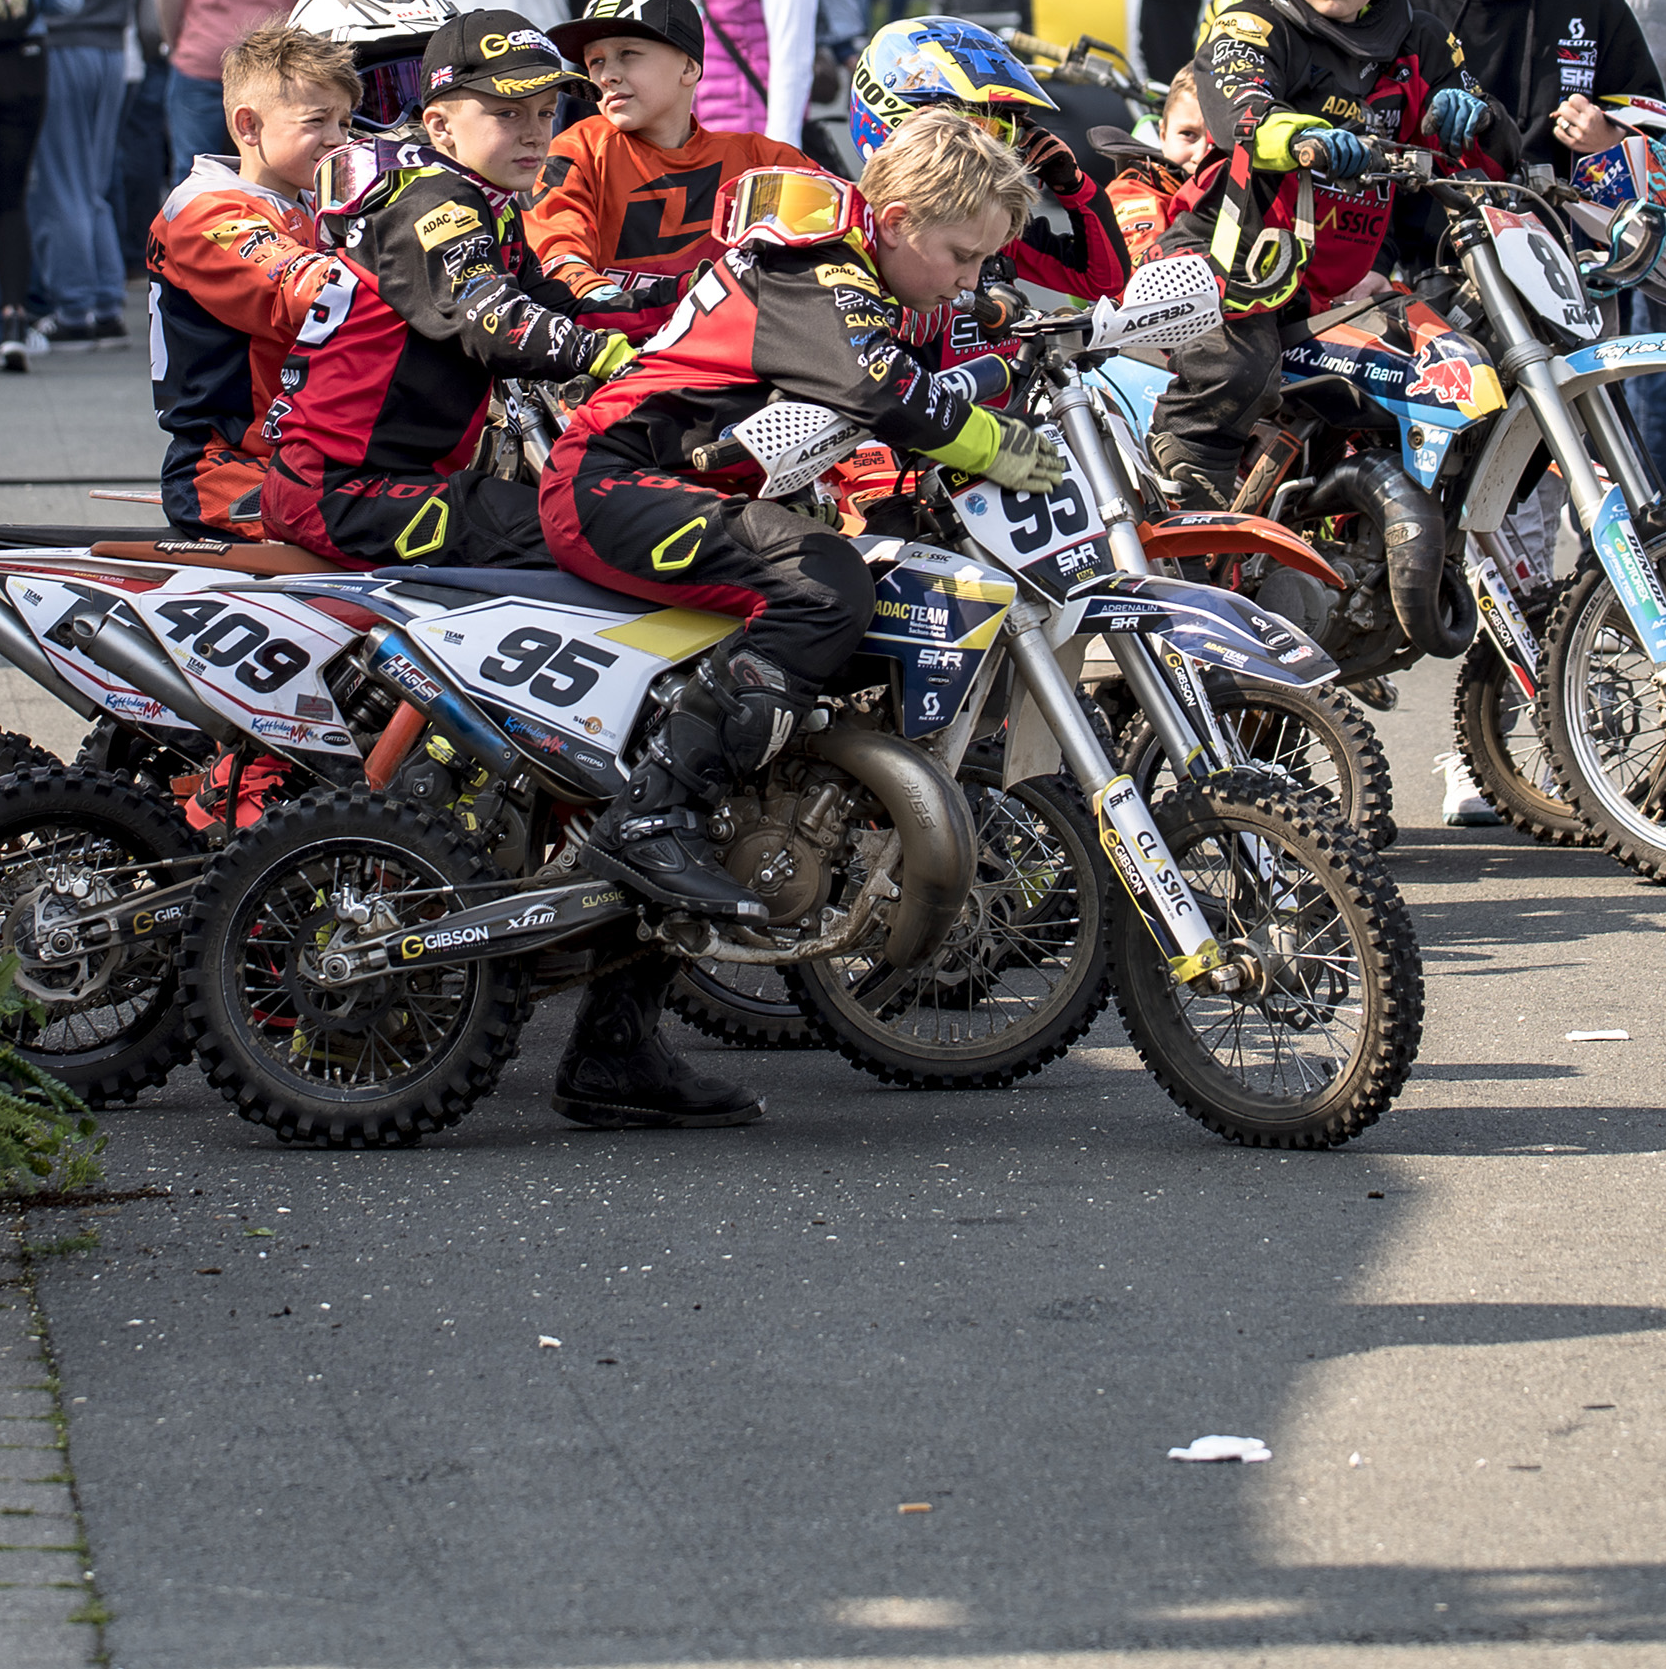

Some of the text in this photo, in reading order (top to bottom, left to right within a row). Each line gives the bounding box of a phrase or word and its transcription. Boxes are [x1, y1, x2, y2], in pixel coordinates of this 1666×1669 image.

[1557, 38, 1597, 48] SCOTT
[1559, 66, 1595, 89] SHR
[1526, 232, 1576, 300] 8
[1123, 302, 1195, 334] ACERBIS
[1562, 302, 1600, 326] KTM
[1281, 346, 1405, 384] MX Junior Team
[1594, 343, 1629, 362] Troy
[1629, 339, 1661, 354] Lee
[795, 424, 861, 465] ACERBIS
[1415, 451, 1436, 470] PPG
[853, 456, 885, 469] SENS
[1000, 454, 1089, 555] 95
[1180, 515, 1213, 526] SHR
[911, 550, 953, 563] CLASSIC
[1055, 541, 1099, 574] SHR
[1620, 551, 1652, 603] MOTOREX
[1101, 603, 1158, 613] ADRENALIN
[1109, 616, 1140, 631] SHR
[1581, 594, 1600, 630] EXCEL
[1488, 607, 1515, 649] GIBSON
[1502, 599, 1541, 656] CLASSI
[154, 599, 311, 694] 409
[917, 649, 964, 668] SHR
[383, 654, 443, 703] HGS
[479, 626, 620, 708] 95
[1174, 665, 1197, 708] GIBSON
[576, 752, 605, 770] ORTEMA
[902, 781, 937, 830] HGS
[1108, 787, 1136, 807] SHR
[1113, 844, 1148, 896] GIBSON
[1130, 830, 1193, 917] CLASSIC
[582, 889, 626, 909] CLASSIC
[424, 925, 490, 951] GIBSON
